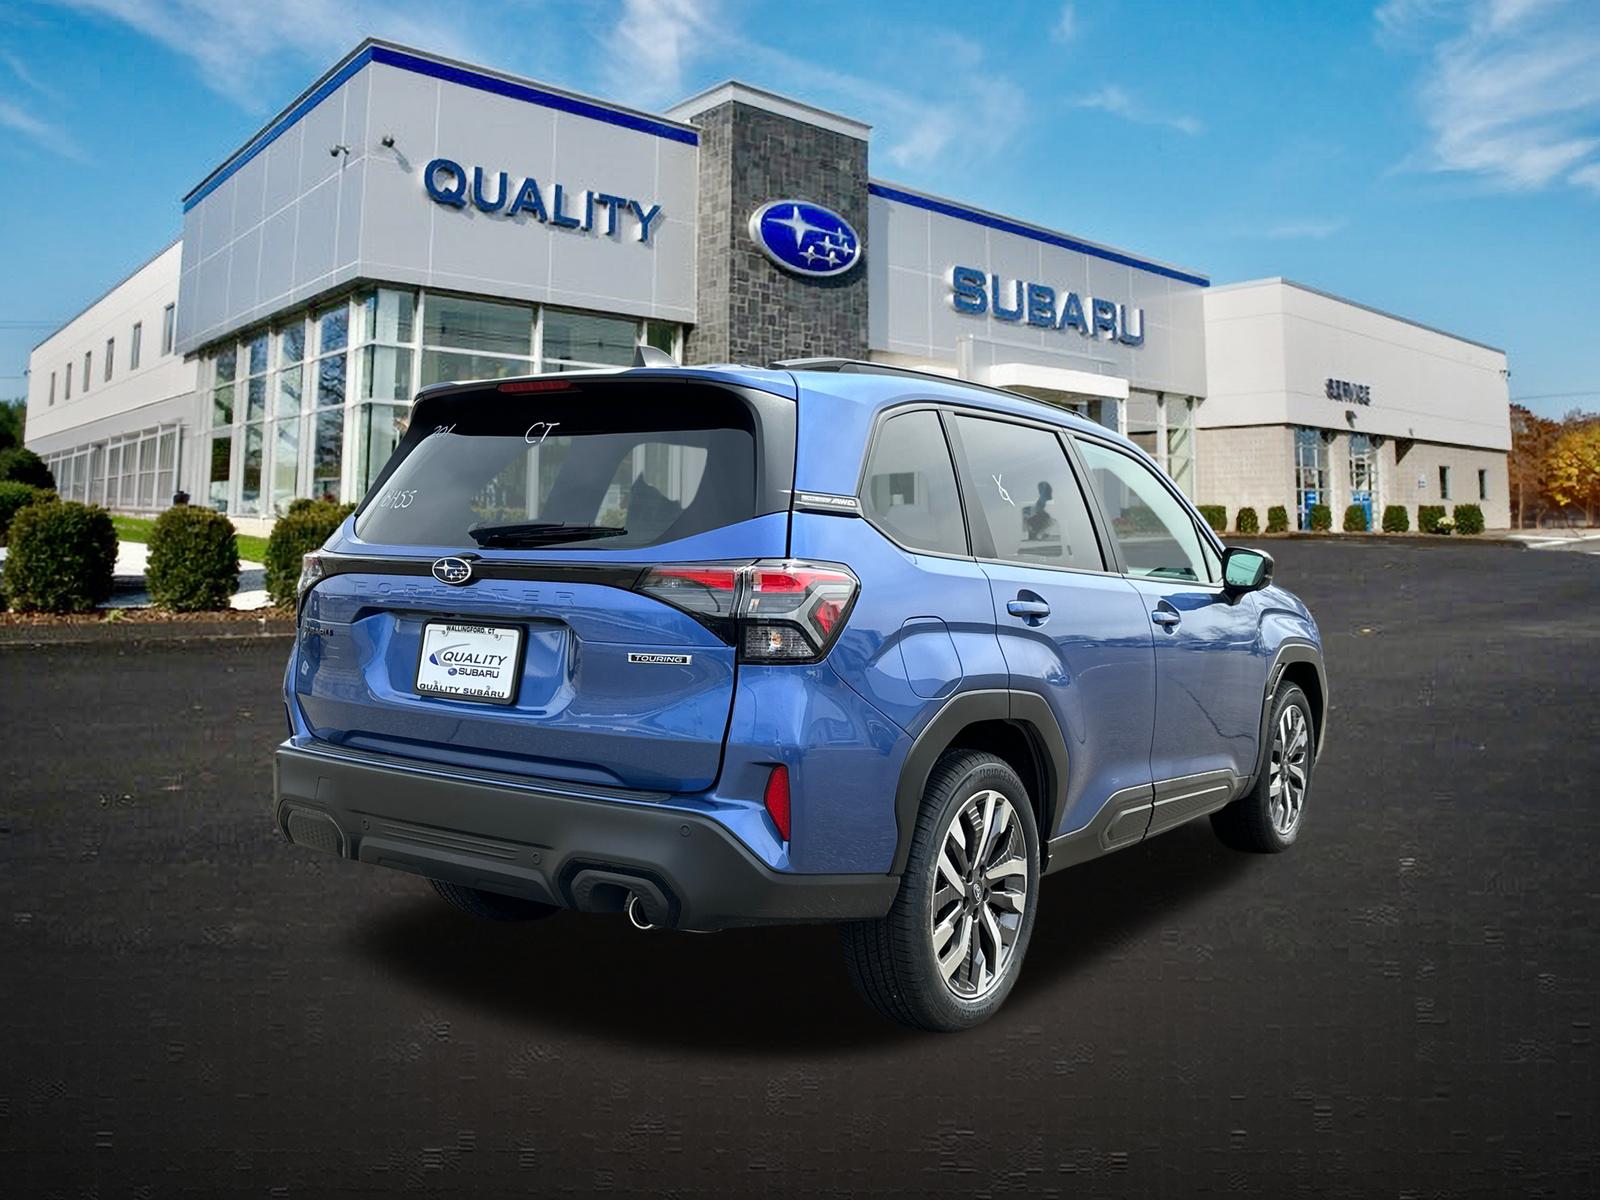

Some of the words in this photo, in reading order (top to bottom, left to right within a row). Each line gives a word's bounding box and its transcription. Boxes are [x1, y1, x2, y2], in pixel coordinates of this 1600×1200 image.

[423, 158, 663, 242] QUALITY
[949, 265, 1145, 346] SUBARU
[524, 422, 560, 444] CT
[352, 581, 577, 607] FORESTER
[443, 651, 508, 666] QUALITY
[634, 655, 683, 663] TOURING
[458, 667, 500, 679] SUBARU
[419, 683, 461, 693] QUALITY
[462, 687, 505, 698] SUBARU
